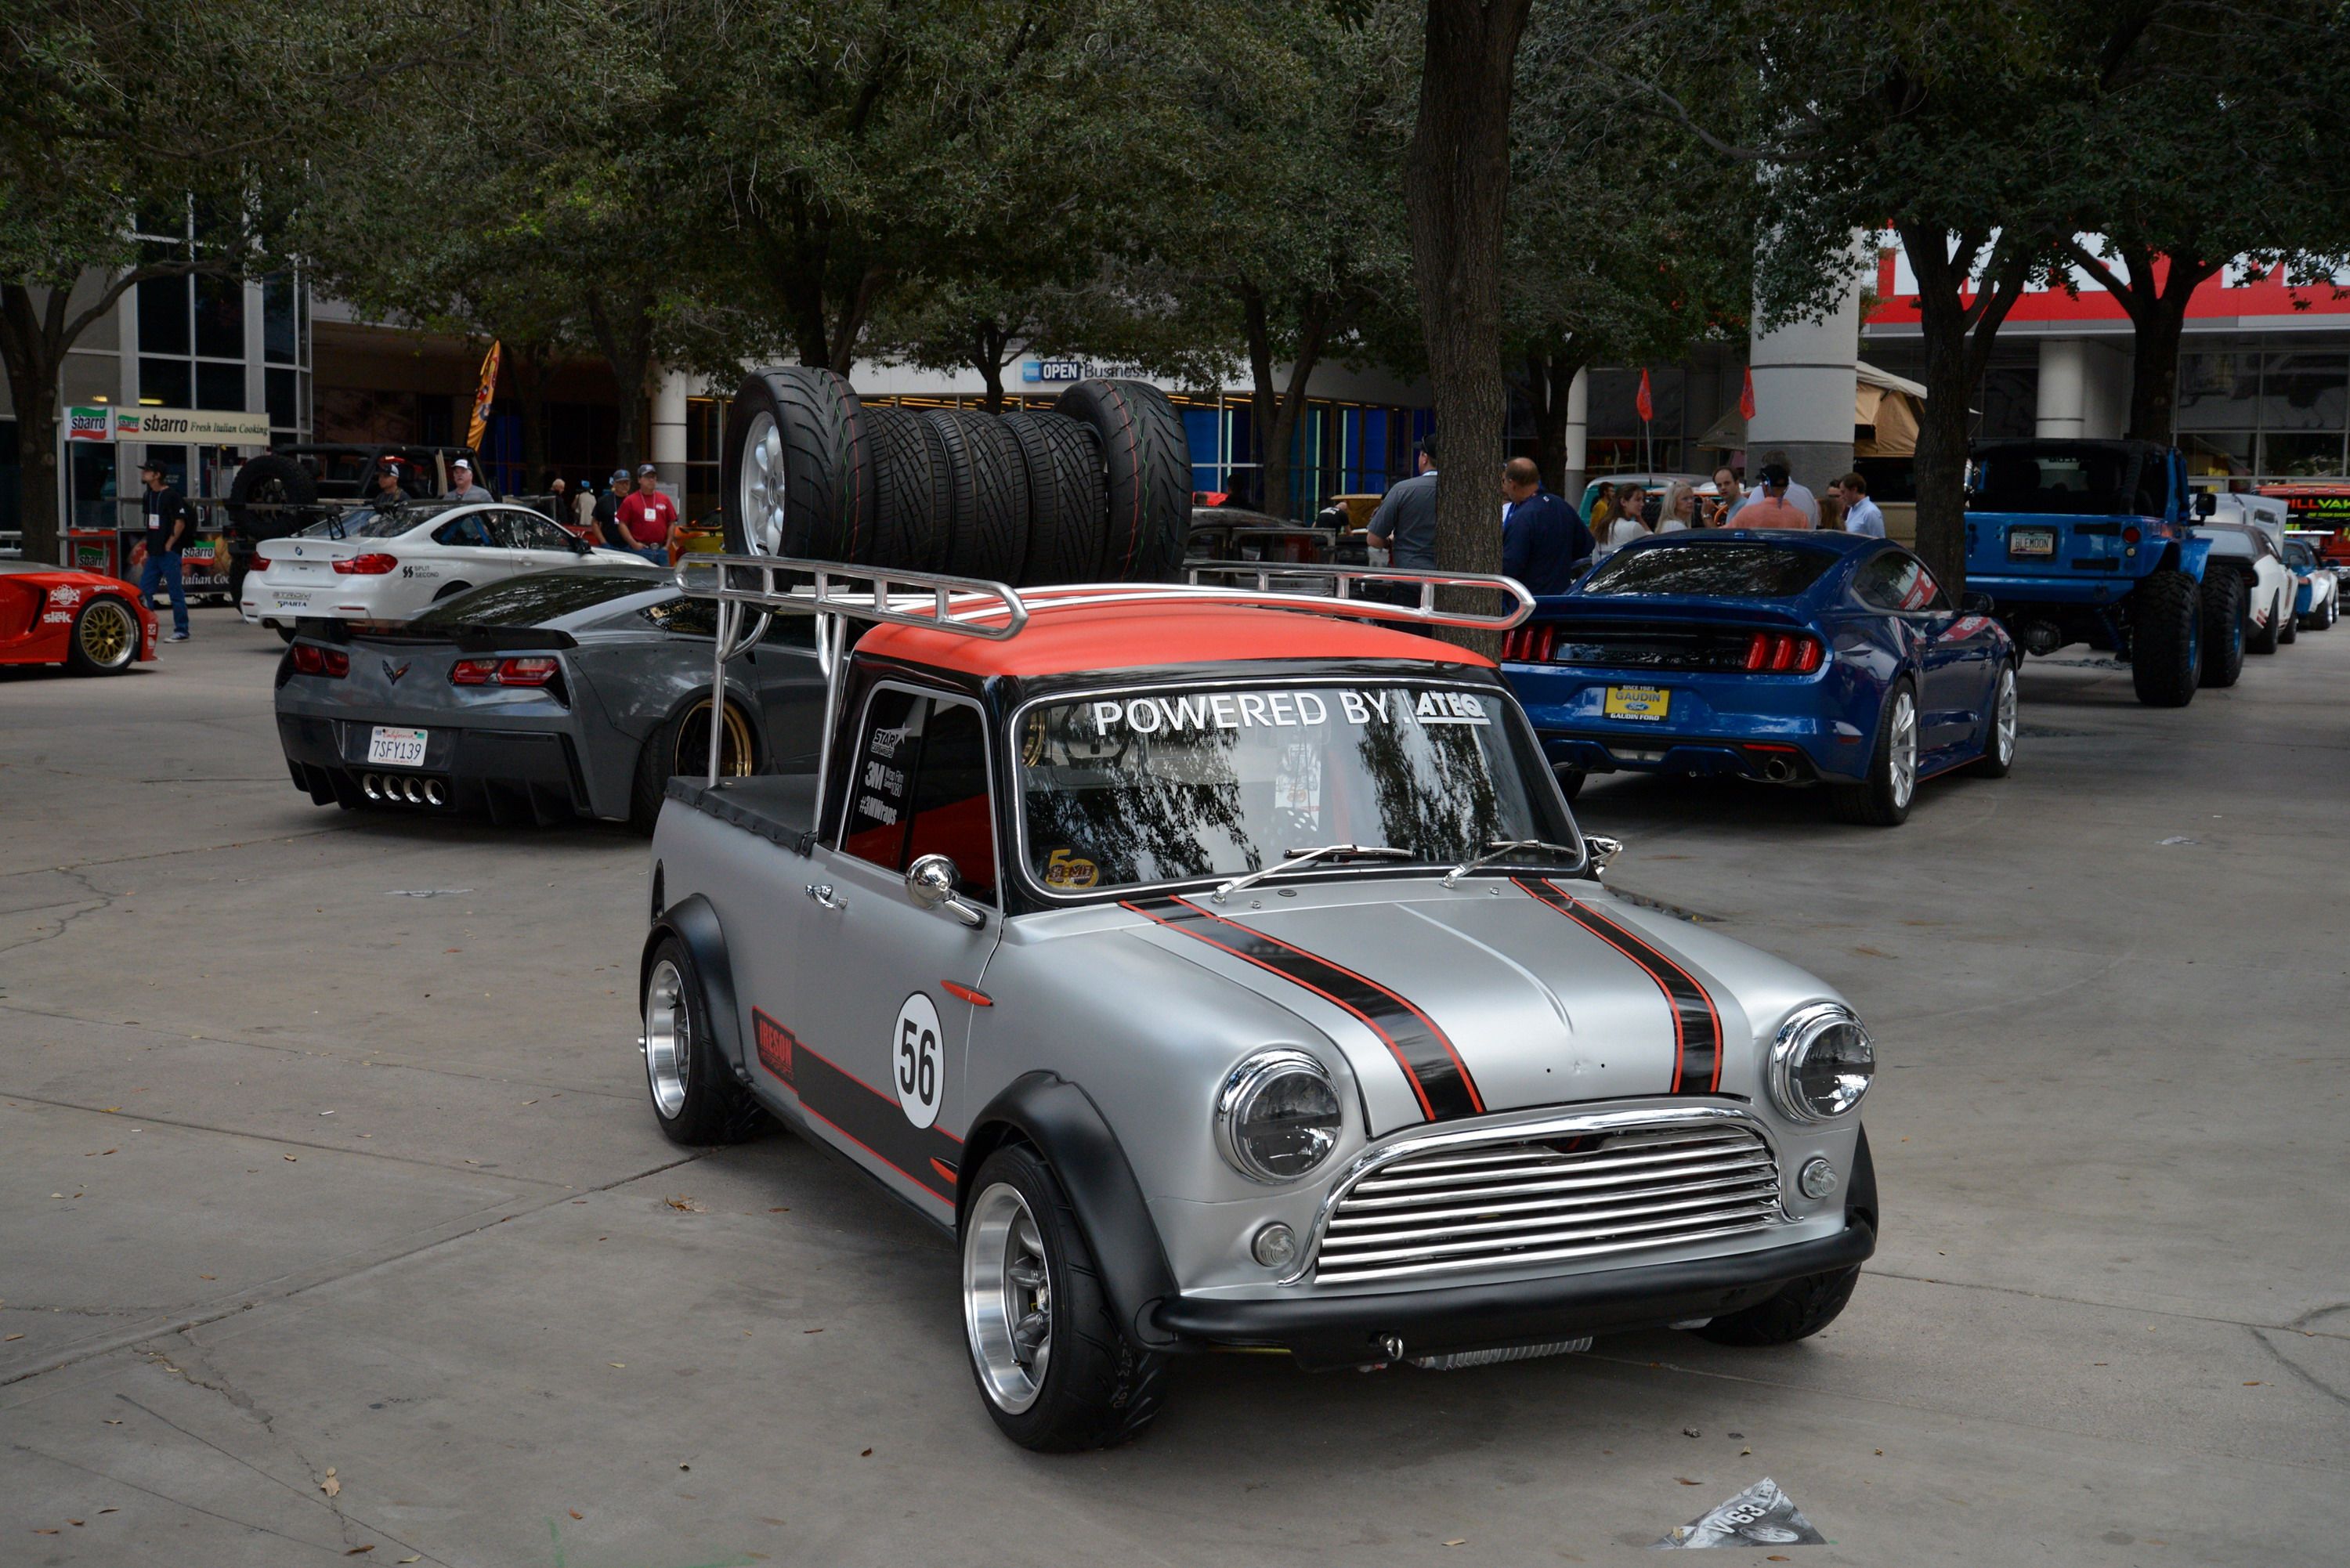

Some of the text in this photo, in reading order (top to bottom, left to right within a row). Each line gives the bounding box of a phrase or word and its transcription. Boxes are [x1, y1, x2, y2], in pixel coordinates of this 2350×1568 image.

[1043, 363, 1077, 379] OPEN
[1084, 363, 1148, 378] Business
[71, 413, 106, 430] sbarro
[118, 417, 139, 428] sbarro
[143, 414, 268, 436] sbarro Fresh Italian Cooking
[184, 547, 214, 558] sbarro
[276, 600, 307, 609] SPARTA
[1615, 691, 1661, 702] GAUDIN
[1094, 692, 1487, 736] POWERED BY ATEQ
[873, 729, 898, 748] STAR
[373, 740, 422, 761] 7SFY139
[865, 761, 904, 790] 3M Wrap Film
[891, 782, 902, 797] 1080
[859, 795, 898, 826] #3MWraps
[759, 1019, 792, 1066] IRESON
[900, 1017, 936, 1106] 56
